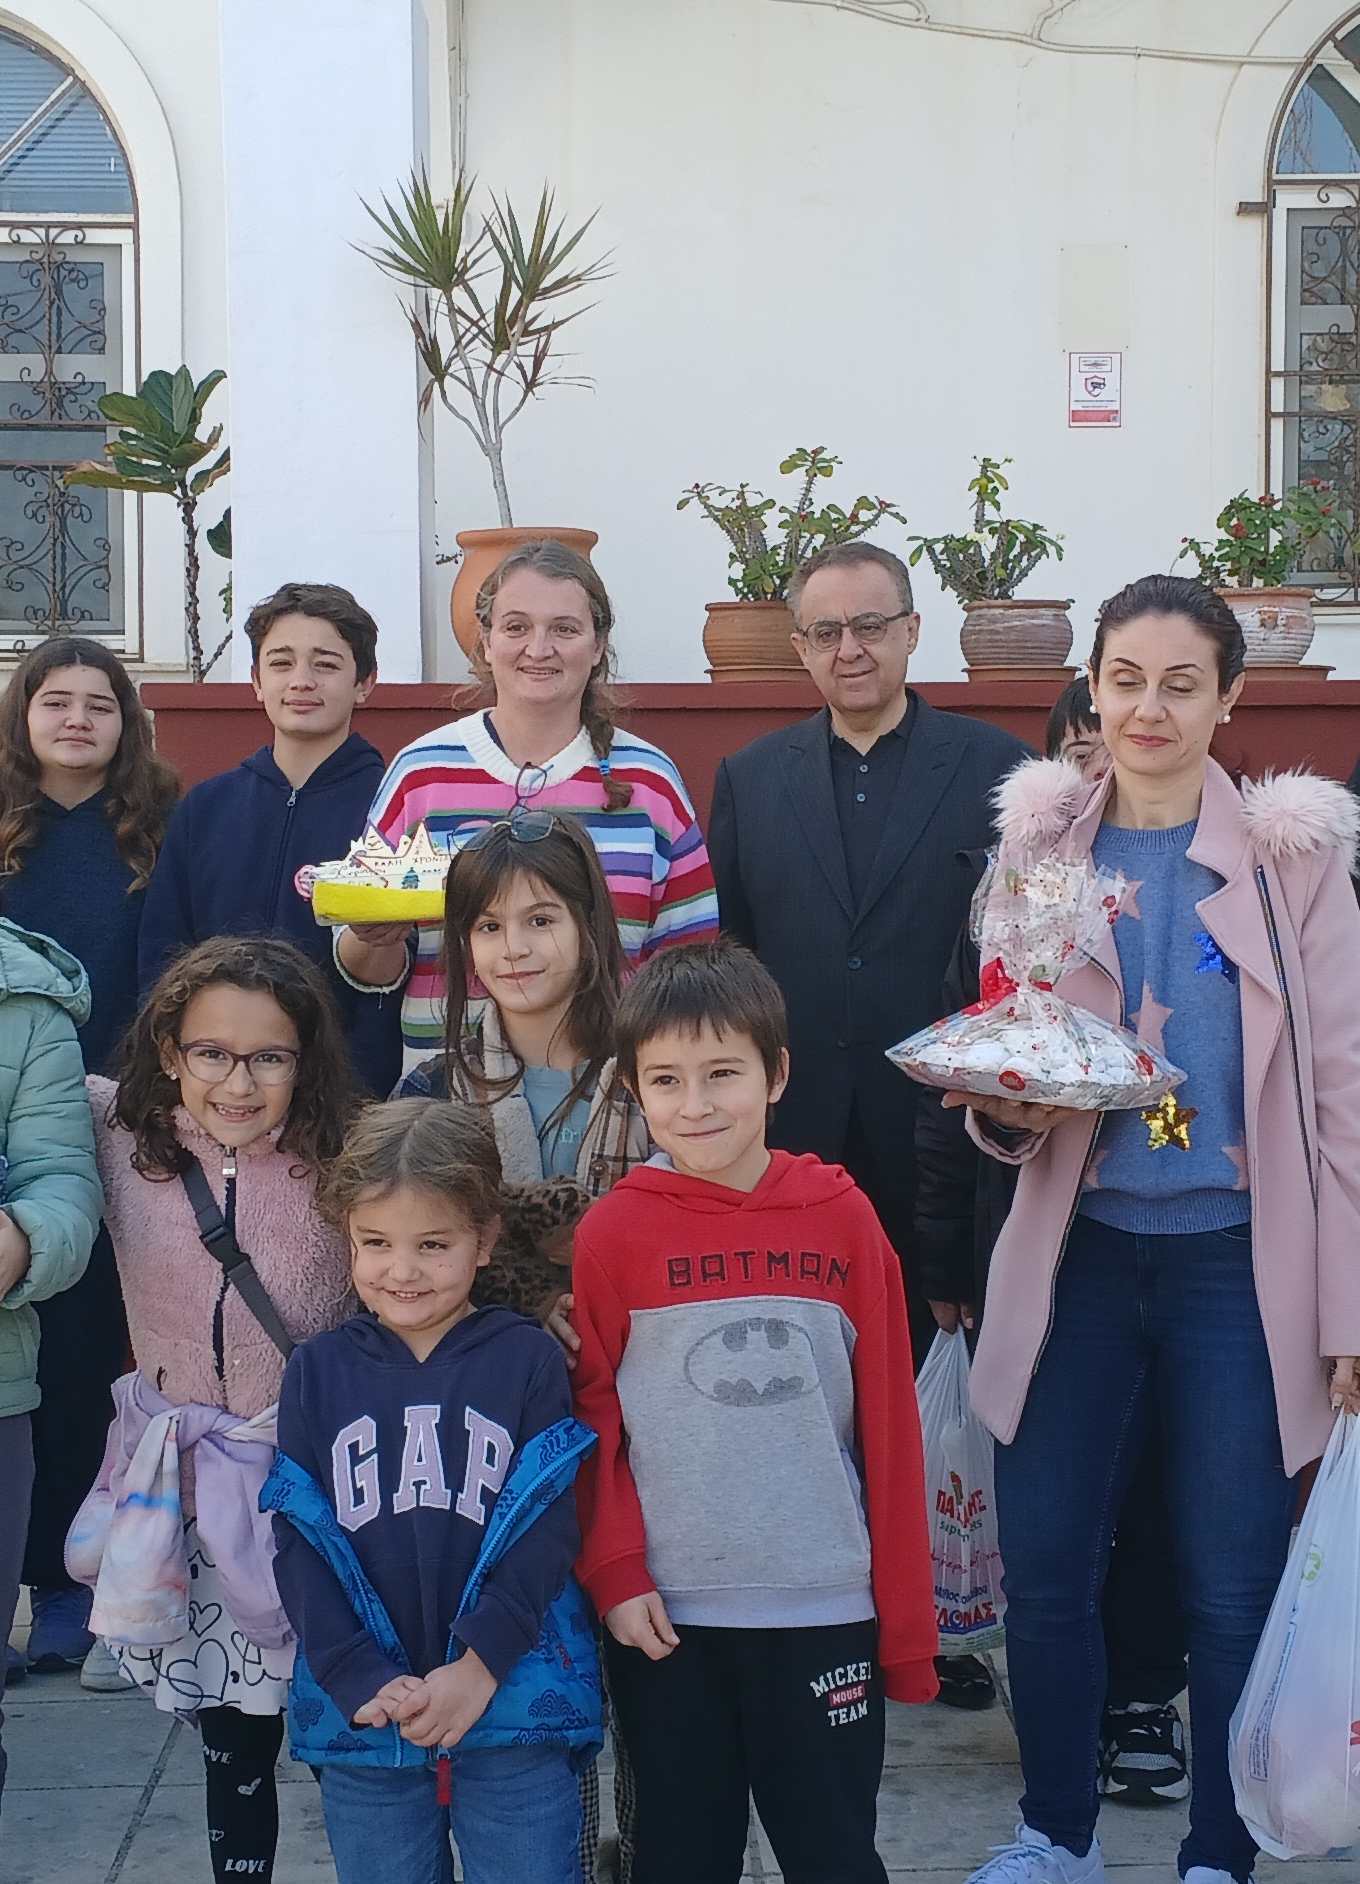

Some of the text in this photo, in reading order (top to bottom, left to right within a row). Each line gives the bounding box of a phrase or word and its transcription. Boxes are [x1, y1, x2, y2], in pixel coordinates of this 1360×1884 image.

[666, 1250, 851, 1288] BATMAN
[331, 1404, 515, 1532] GAP
[831, 1685, 863, 1705] MOUSE
[827, 1699, 869, 1727] TEAM
